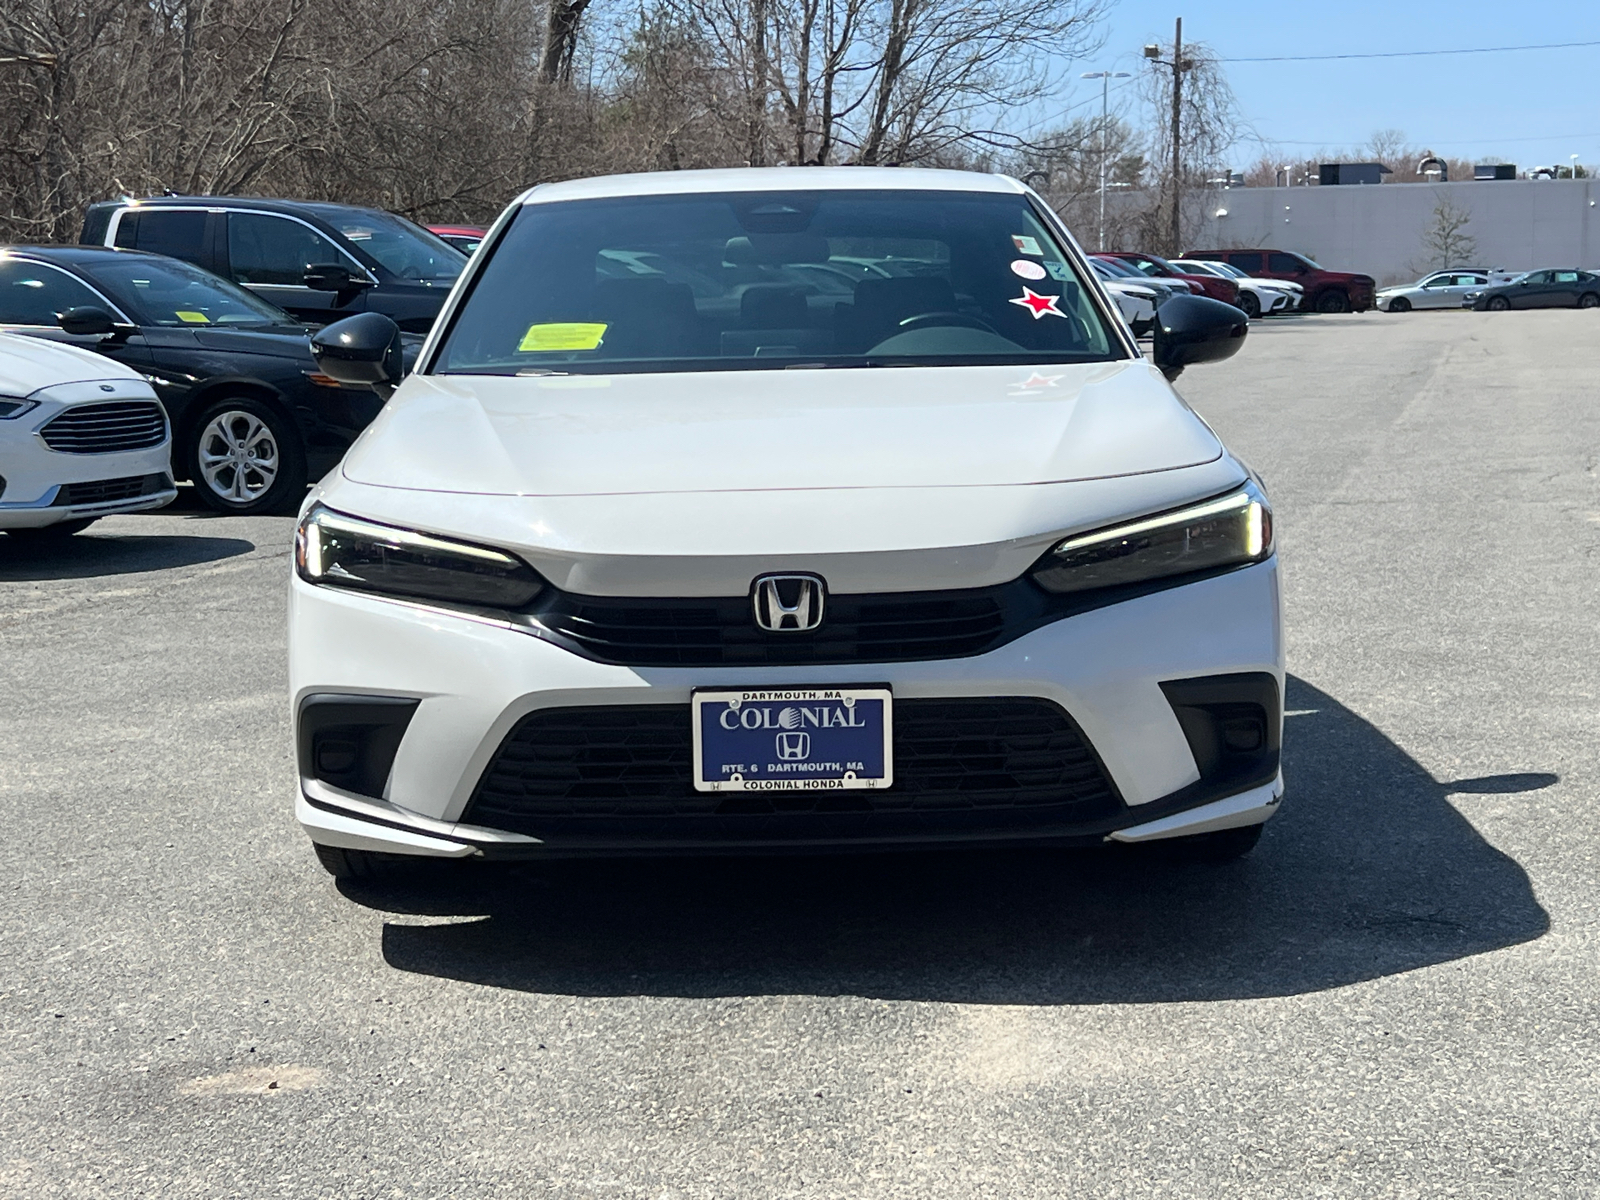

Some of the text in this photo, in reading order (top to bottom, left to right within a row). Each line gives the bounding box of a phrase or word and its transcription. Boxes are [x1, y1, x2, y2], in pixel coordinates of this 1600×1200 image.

[742, 691, 842, 700] DARTMOUTH, MA
[720, 707, 866, 730] COLONIAL
[721, 761, 864, 773] RTE. 6 DARTMOUTH, MA
[743, 780, 844, 790] COLONIAL HONDA
